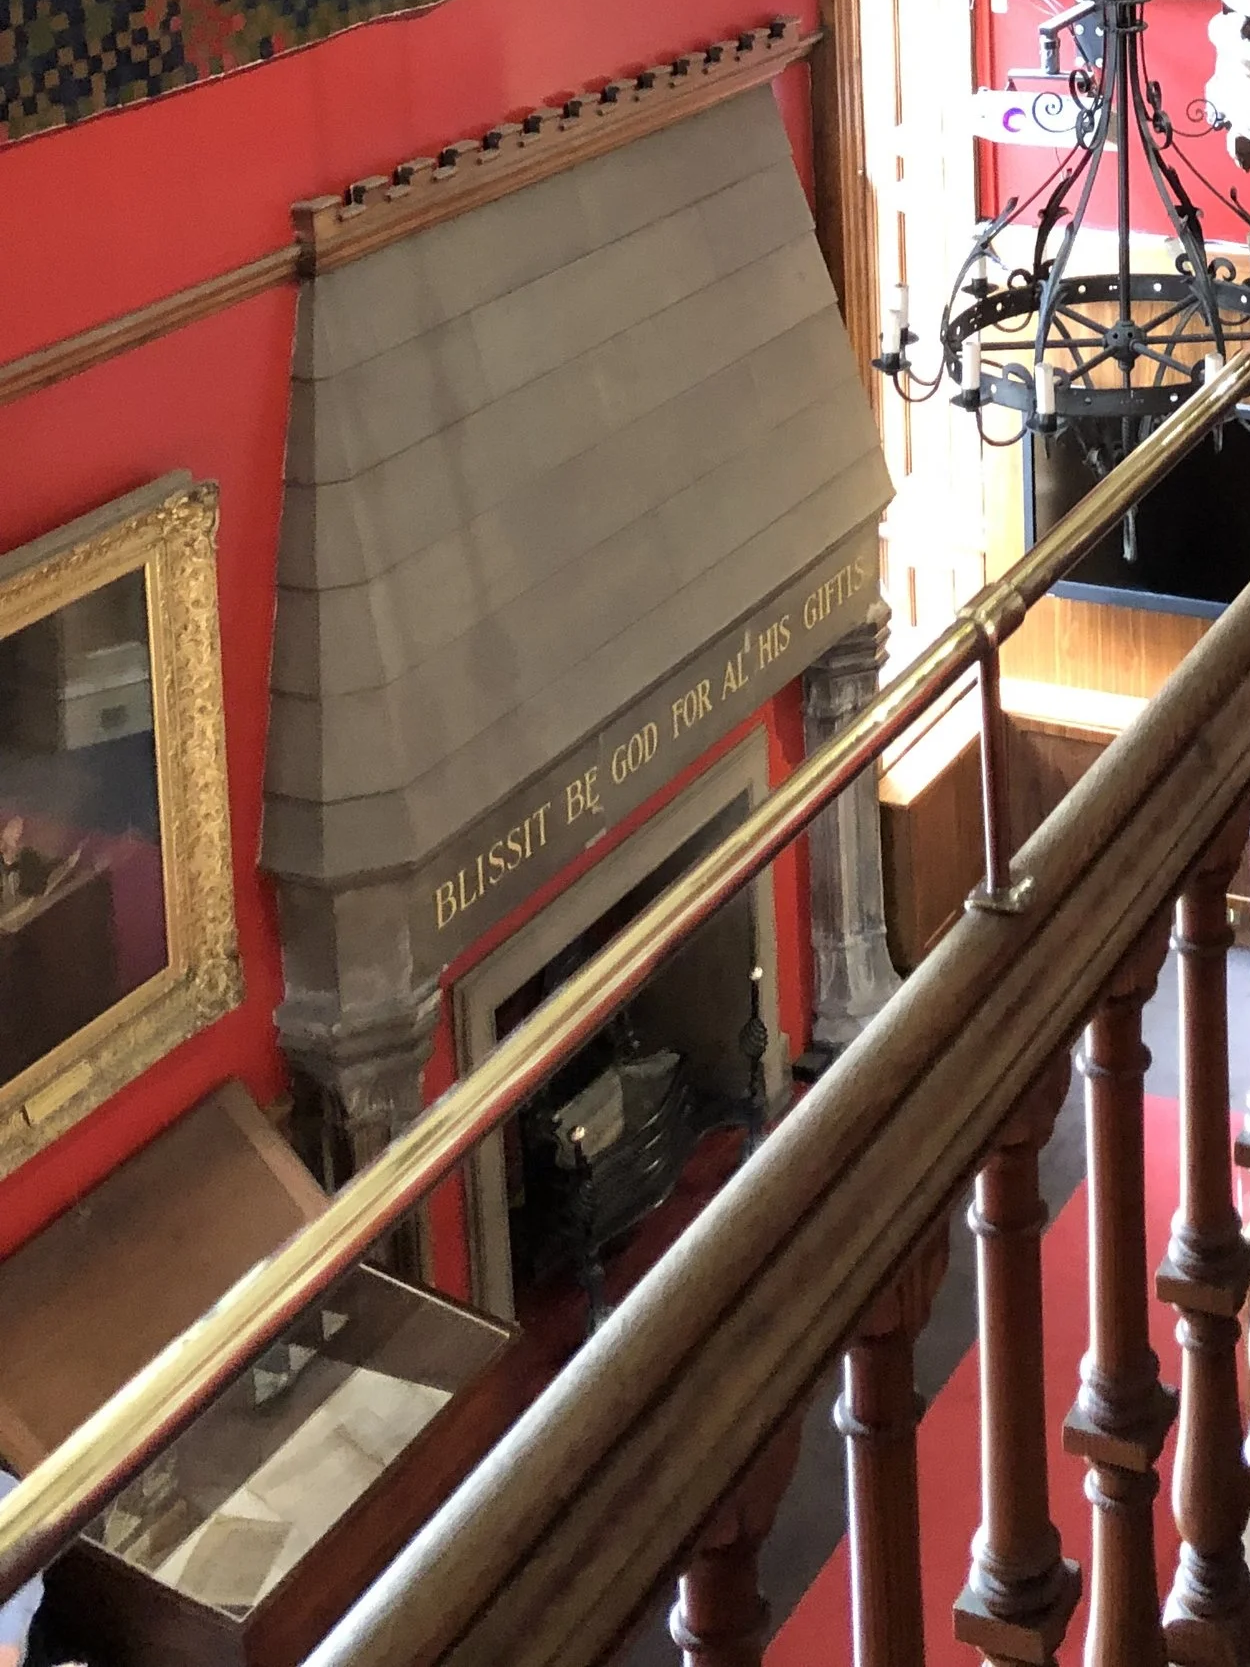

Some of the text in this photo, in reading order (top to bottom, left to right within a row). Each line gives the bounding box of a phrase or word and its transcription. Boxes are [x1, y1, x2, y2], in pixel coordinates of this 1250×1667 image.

[435, 801, 551, 930] BLISSIT
[566, 765, 600, 825] BE
[611, 722, 658, 784] GOD
[671, 678, 713, 741] FOR
[758, 614, 791, 670] HIS
[803, 556, 865, 630] GIFTIS
